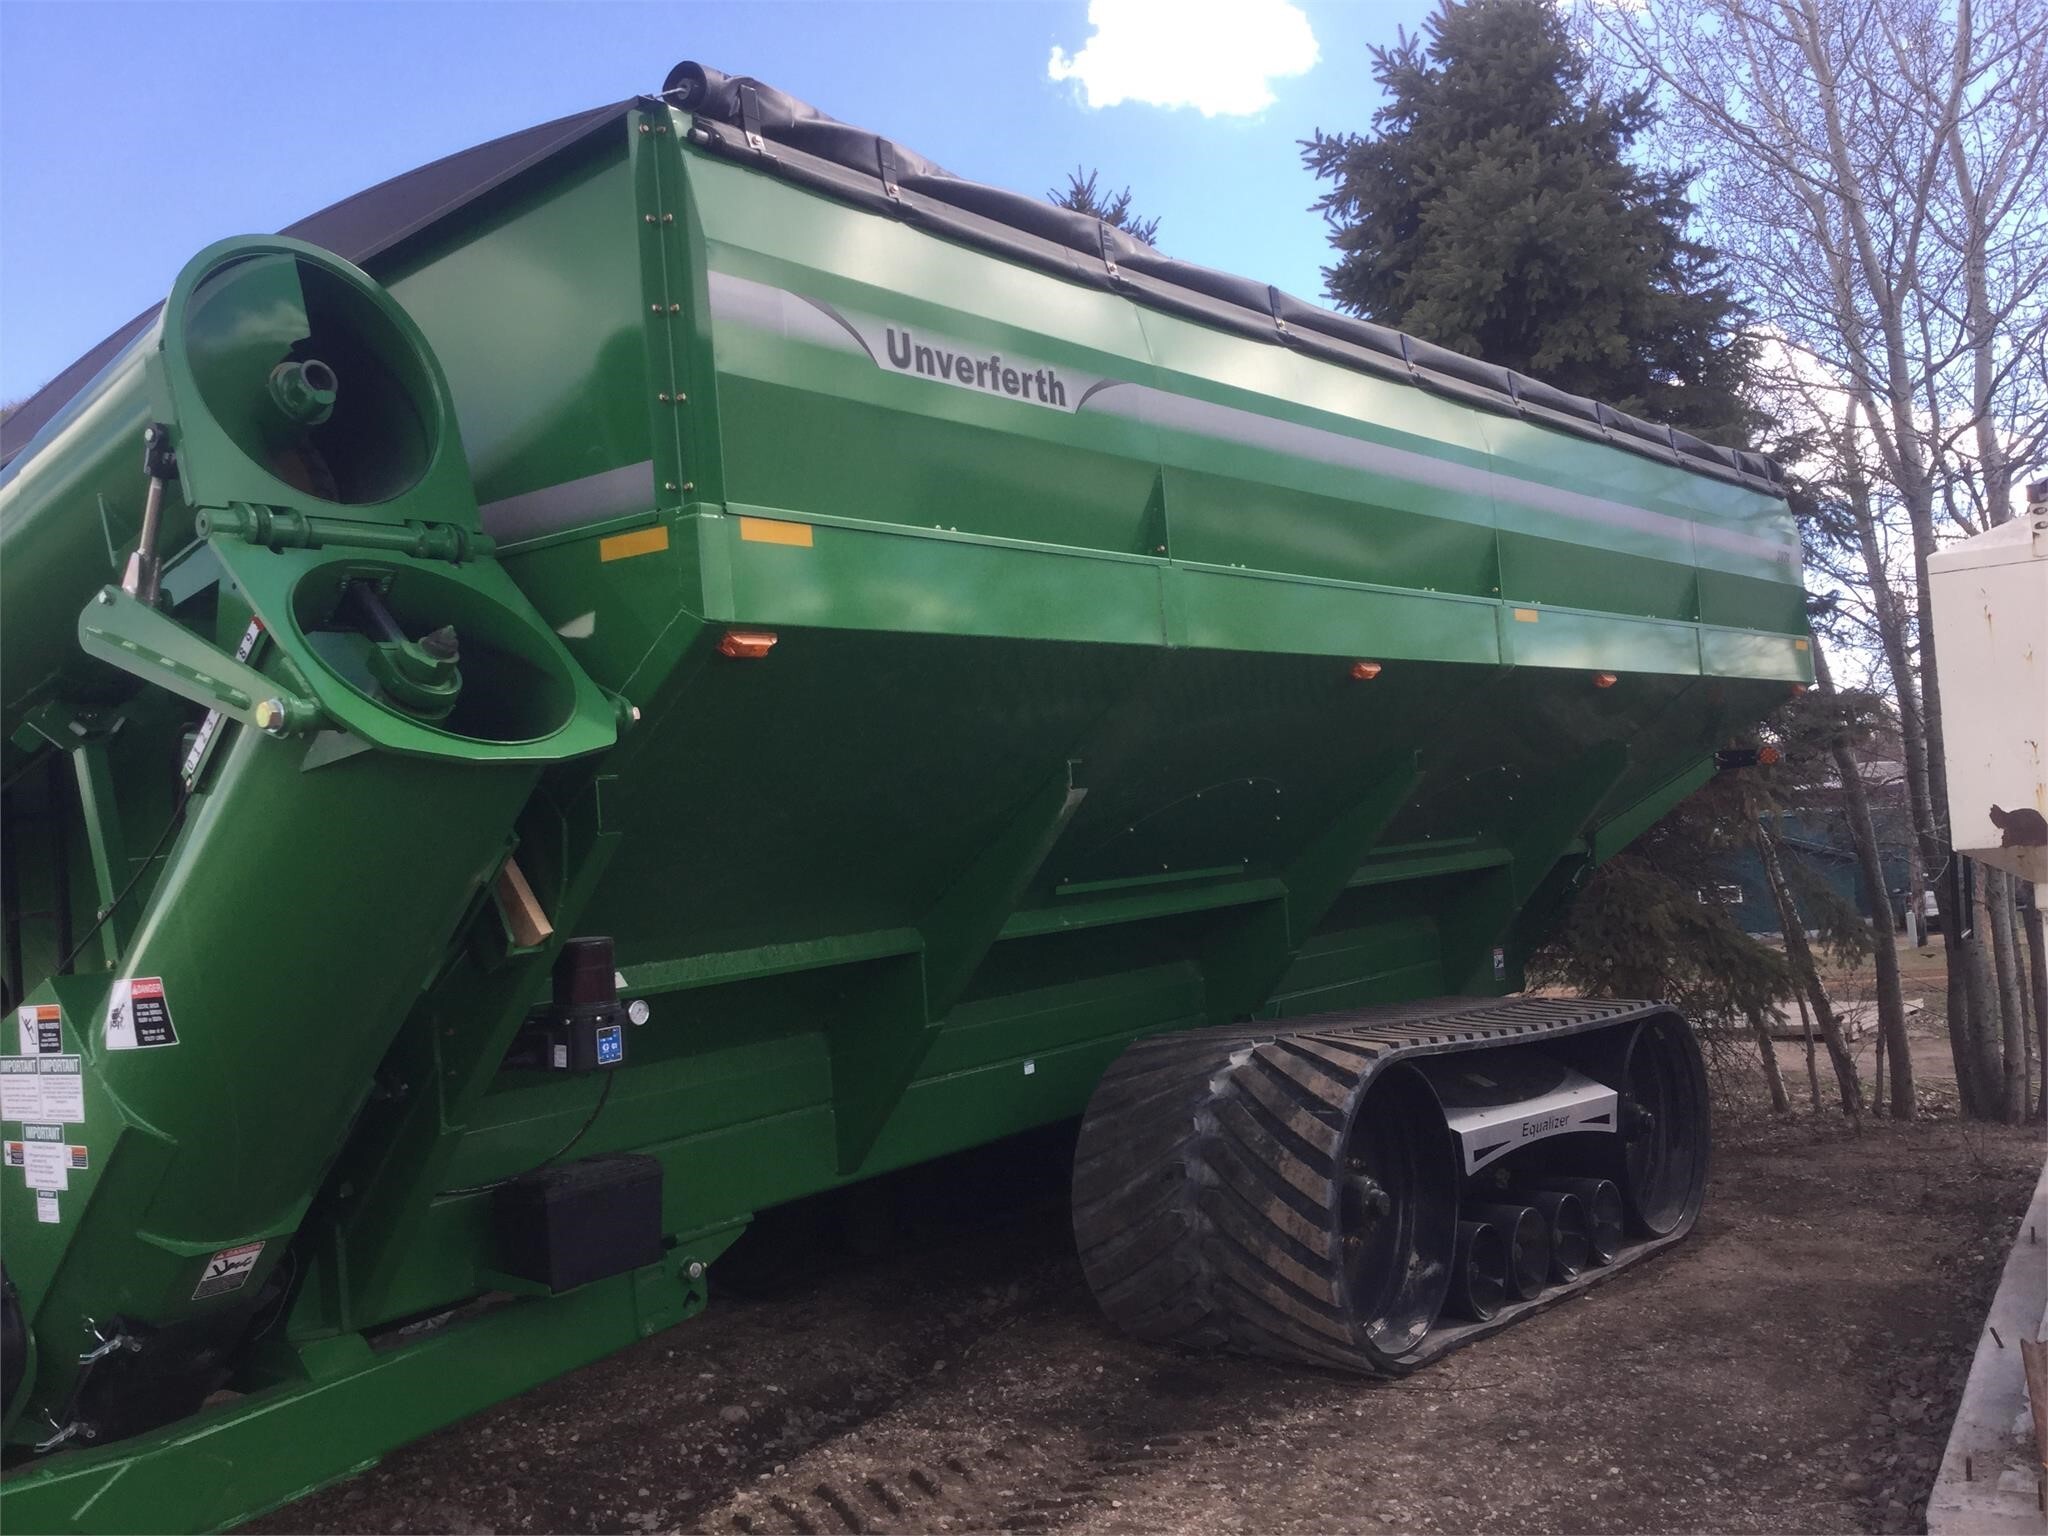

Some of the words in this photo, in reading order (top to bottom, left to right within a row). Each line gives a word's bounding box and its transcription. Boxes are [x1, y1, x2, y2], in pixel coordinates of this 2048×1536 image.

[886, 328, 1067, 407] Unverferth
[207, 718, 214, 731] 3
[239, 647, 247, 659] 8
[0, 1060, 36, 1073] IMPORTANT
[40, 1059, 79, 1073] IMPORTANT
[25, 1126, 61, 1140] IMPORTANT
[1522, 1115, 1569, 1137] Equalizer
